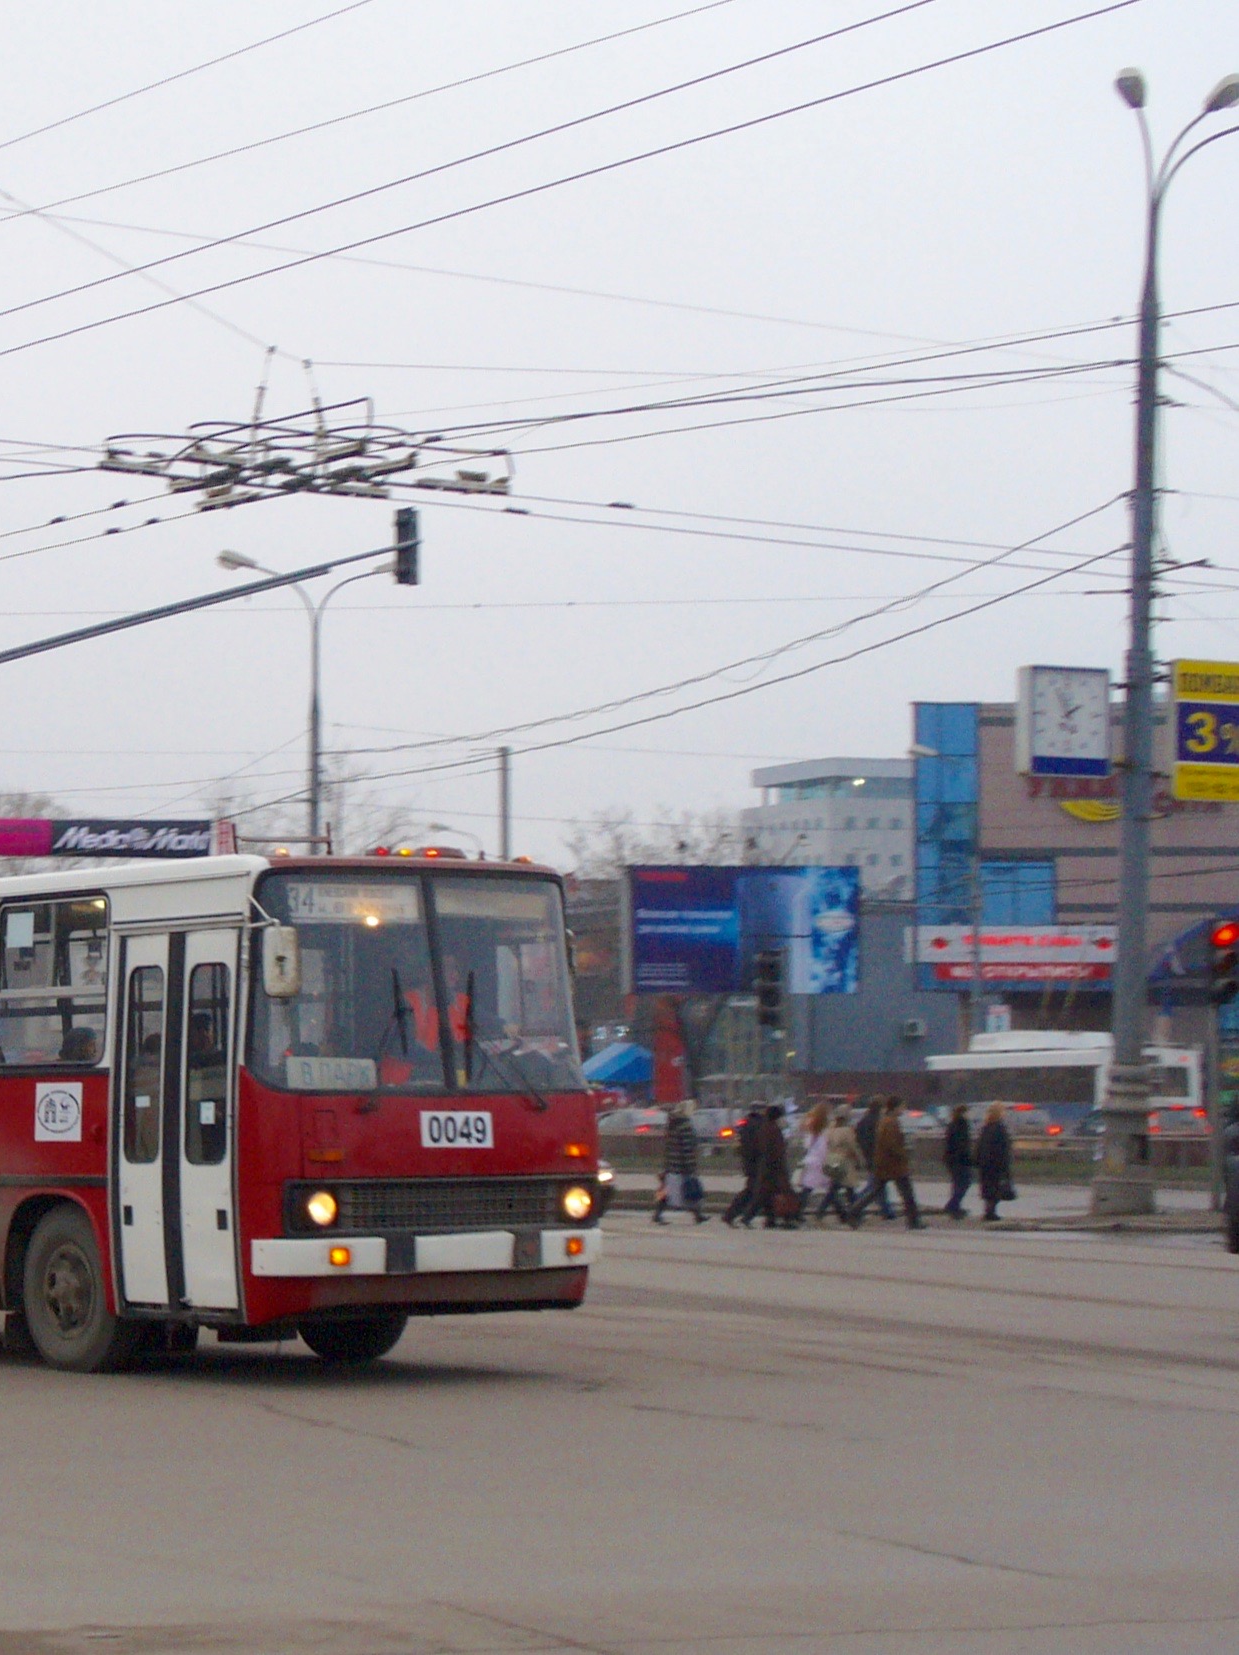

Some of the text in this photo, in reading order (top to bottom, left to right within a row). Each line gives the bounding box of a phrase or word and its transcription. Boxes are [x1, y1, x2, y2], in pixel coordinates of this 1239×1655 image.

[1178, 672, 1239, 695] ЛОМБА
[288, 886, 314, 914] 34
[429, 1115, 487, 1143] 0049
